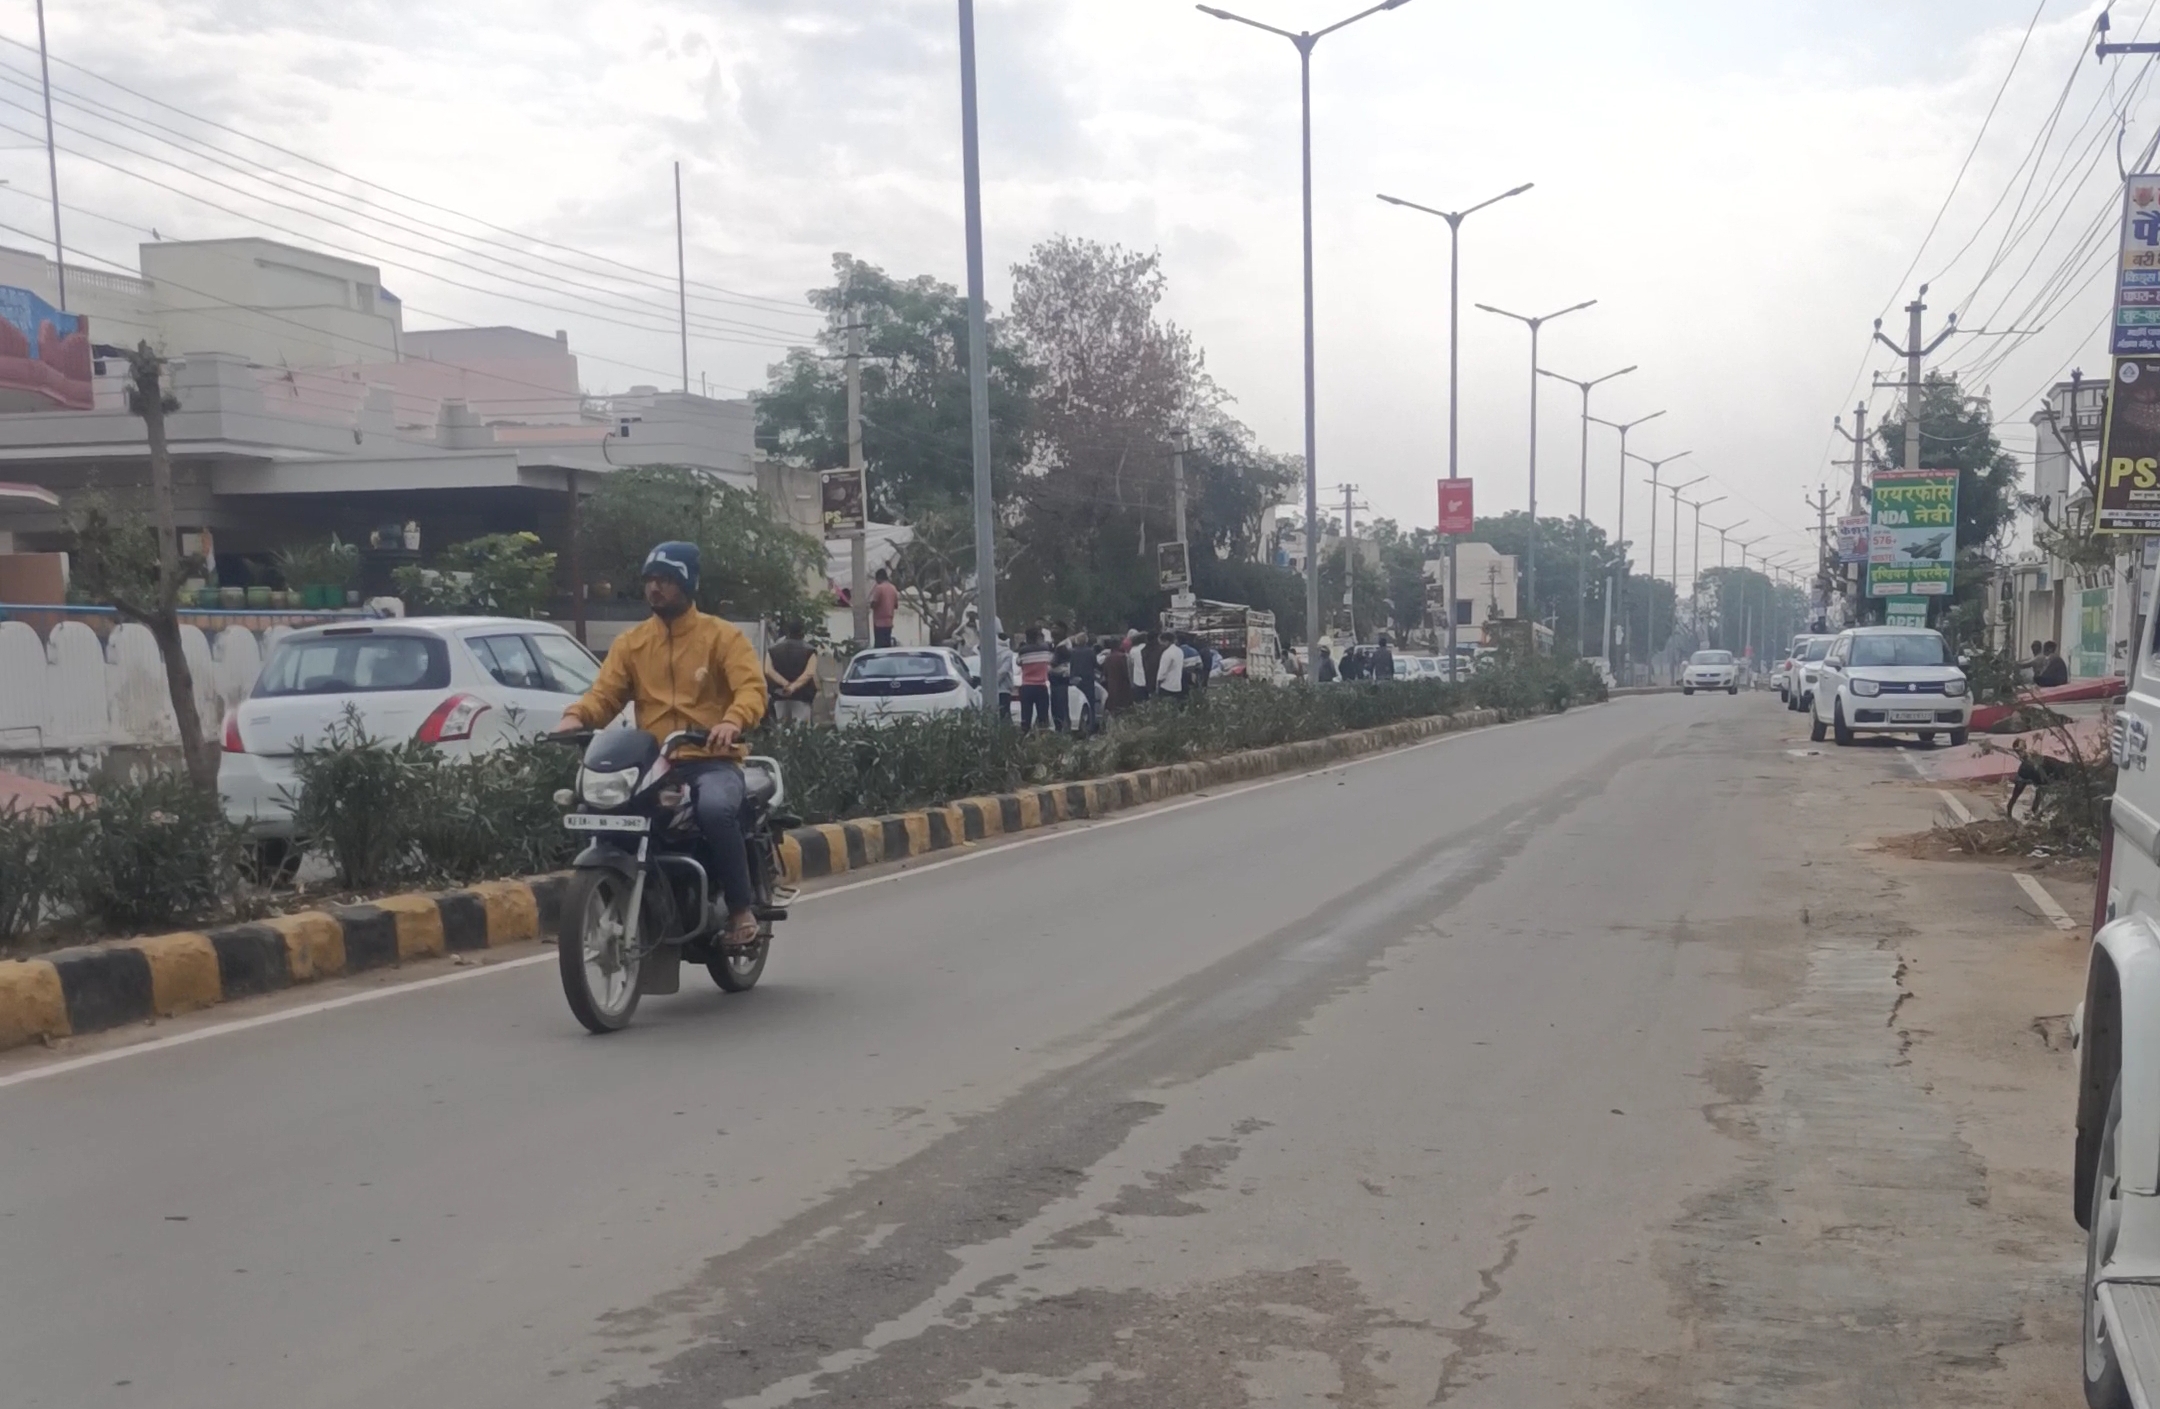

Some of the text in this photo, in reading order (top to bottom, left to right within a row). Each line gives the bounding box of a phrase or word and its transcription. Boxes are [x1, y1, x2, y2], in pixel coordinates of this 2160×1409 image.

[1875, 477, 1954, 507] एयरफोर्स
[1877, 510, 1909, 524] NDA
[1914, 503, 1952, 523] नेवी
